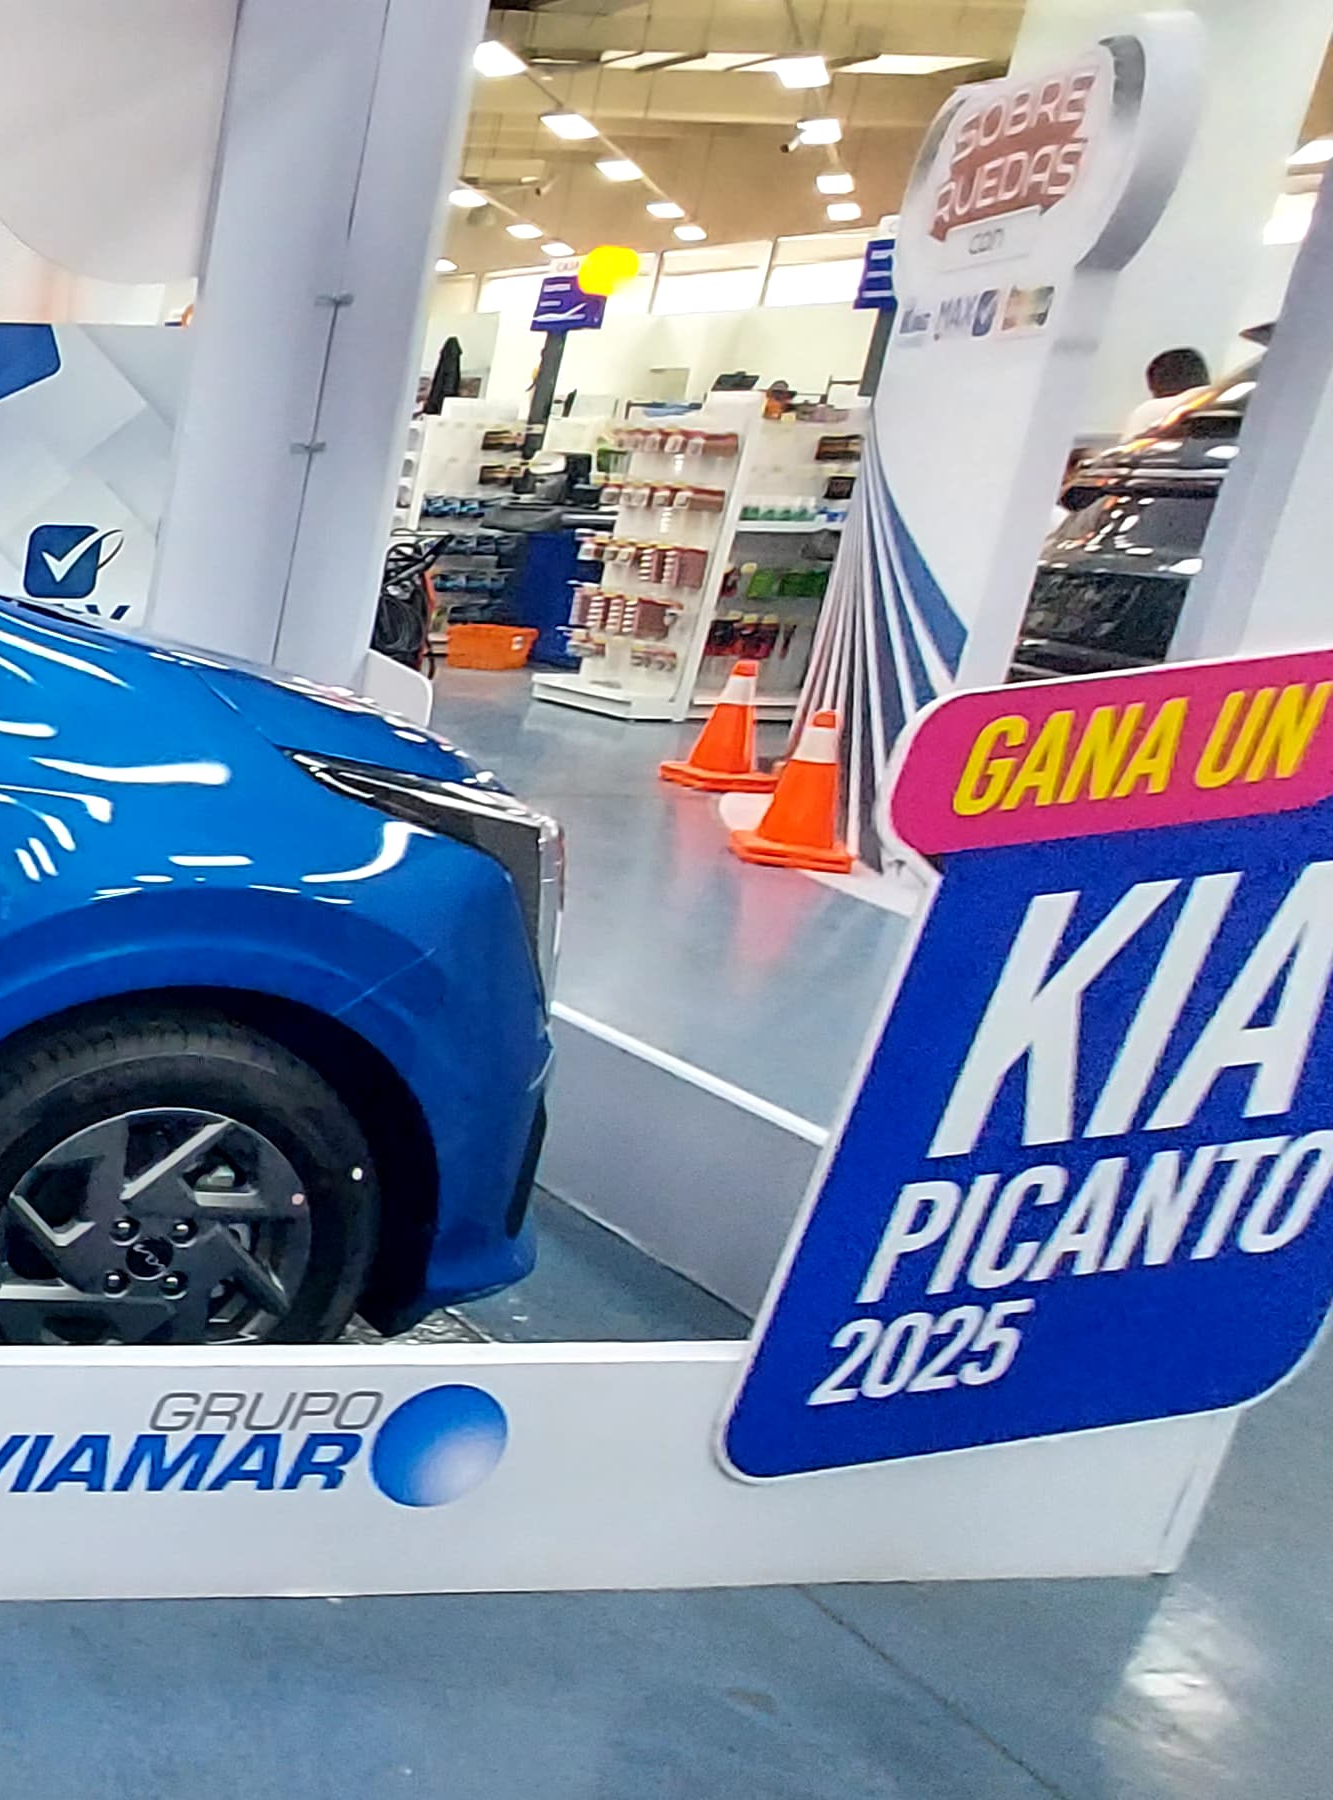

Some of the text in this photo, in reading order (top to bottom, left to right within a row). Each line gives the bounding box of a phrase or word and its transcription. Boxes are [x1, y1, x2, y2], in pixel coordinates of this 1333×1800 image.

[951, 74, 1095, 164] SOBRE
[934, 143, 1083, 223] RUEDAS
[953, 682, 1333, 816] GANA UN
[929, 860, 1333, 1157] KIA
[858, 1130, 1333, 1302] PICANTO
[807, 1299, 1035, 1405] 2025
[149, 1391, 383, 1431] GRUPO
